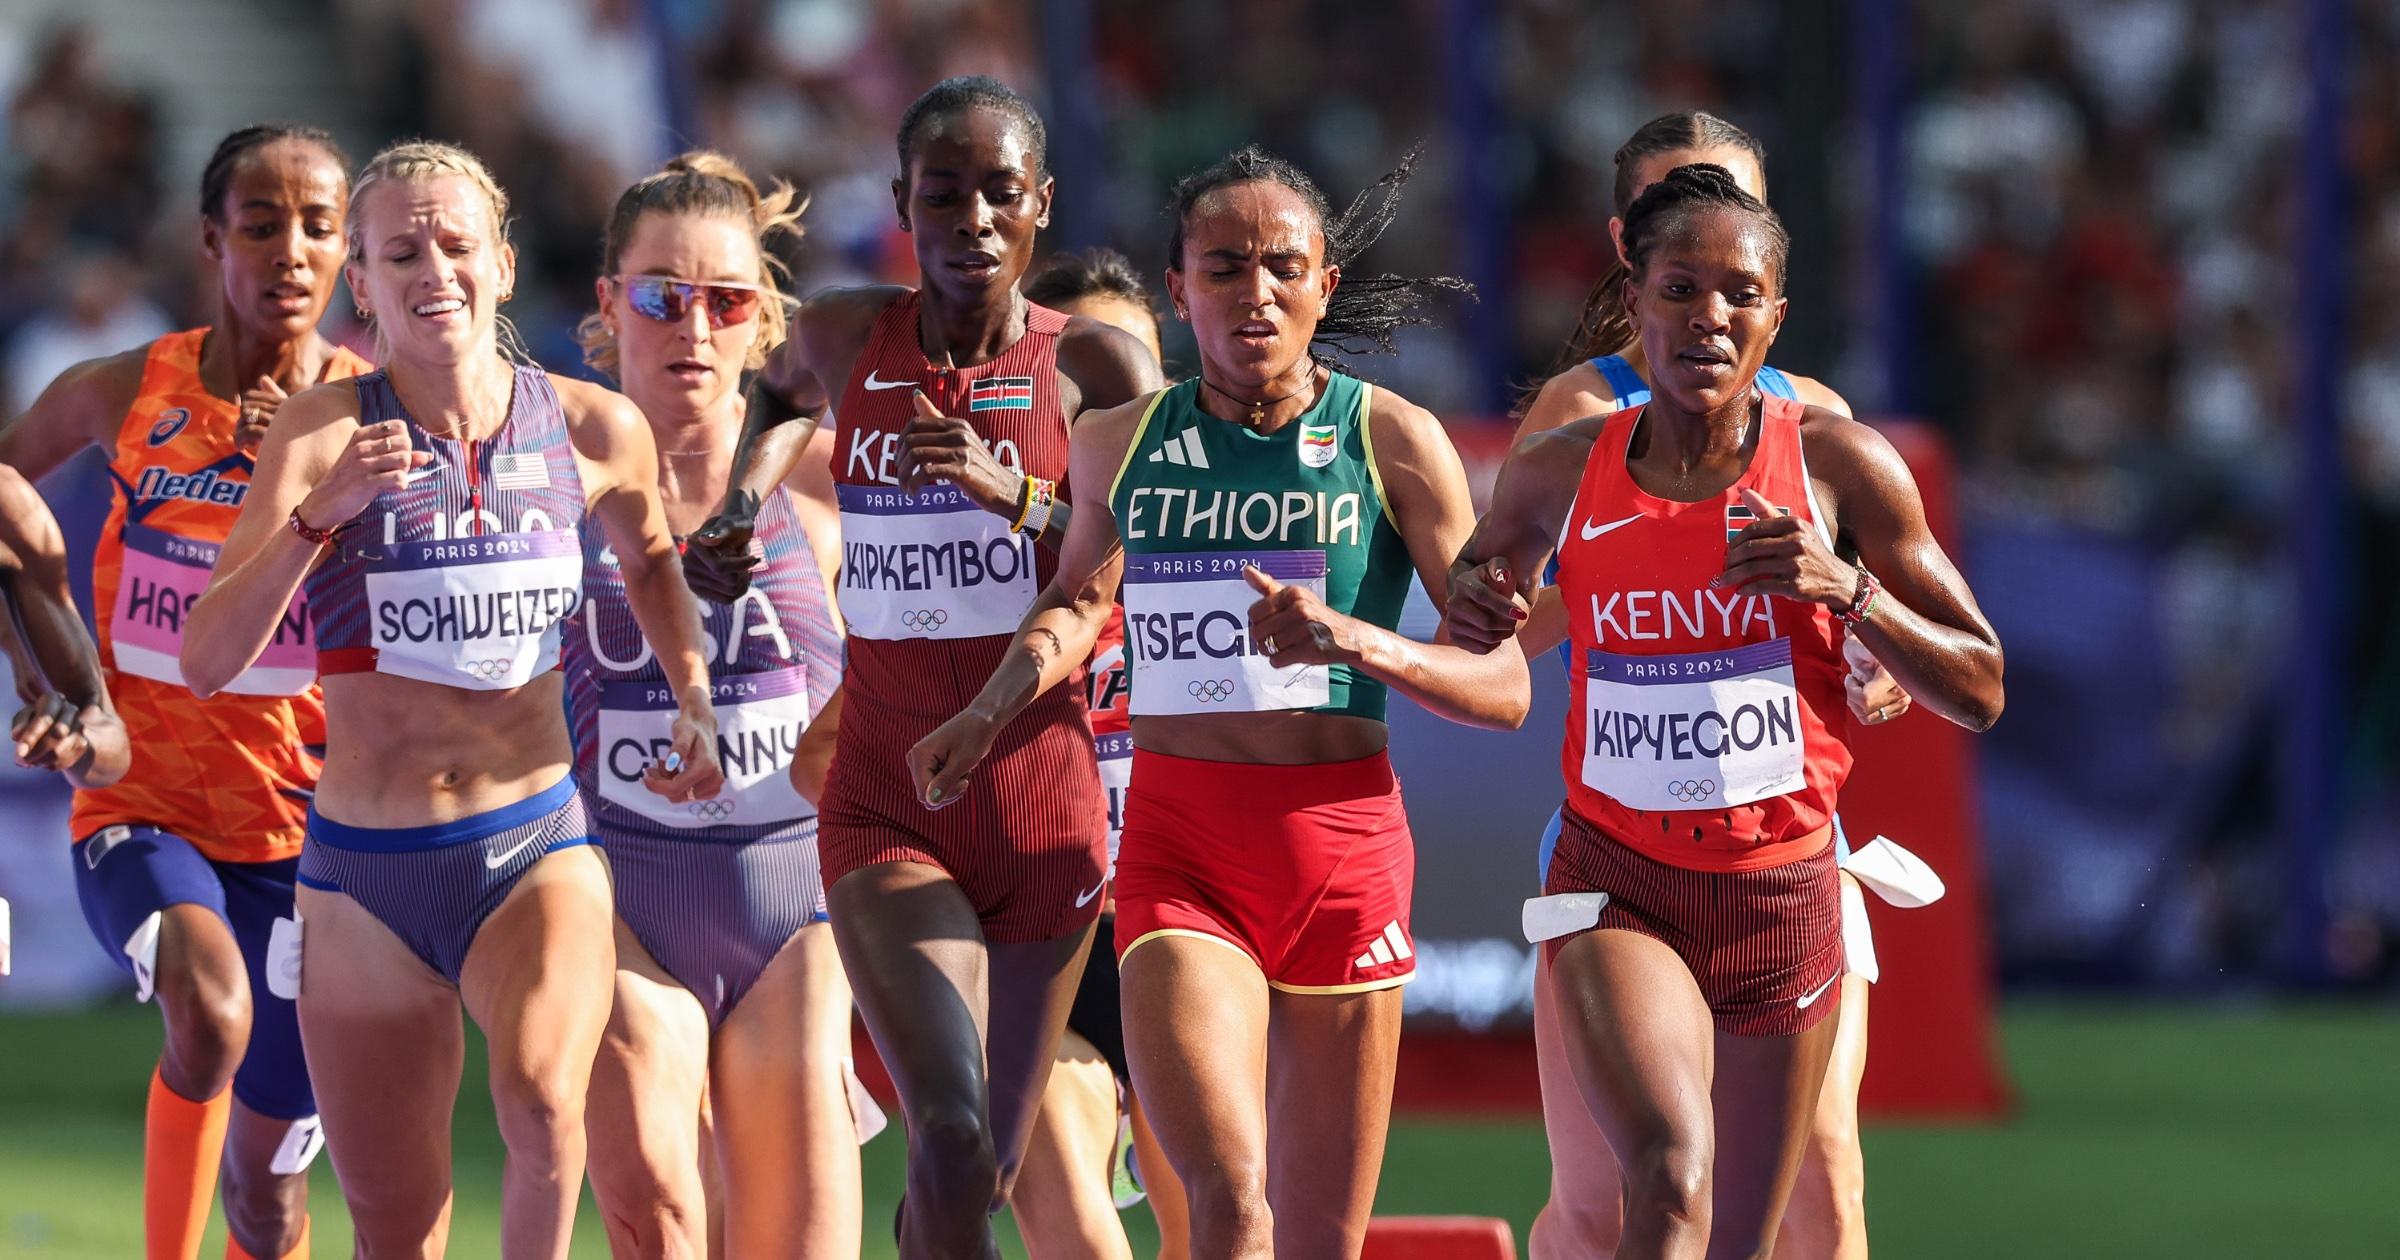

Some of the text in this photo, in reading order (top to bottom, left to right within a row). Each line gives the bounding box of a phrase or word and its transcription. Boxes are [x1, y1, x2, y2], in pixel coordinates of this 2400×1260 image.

[848, 428, 1024, 486] KEA
[135, 466, 250, 508] Neder
[1128, 487, 1360, 546] ETHIOPIA
[484, 539, 530, 556] 2024
[846, 536, 1030, 592] KIPKEMBOI
[1211, 558, 1261, 573] 2024
[127, 576, 308, 645] HAN
[586, 586, 792, 672] UA
[1131, 610, 1259, 662] TSEG
[1591, 588, 1777, 644] KENYA
[1686, 657, 1735, 675] 2024
[608, 720, 803, 783] CNNY
[1593, 695, 1796, 761] KIPYEGON
